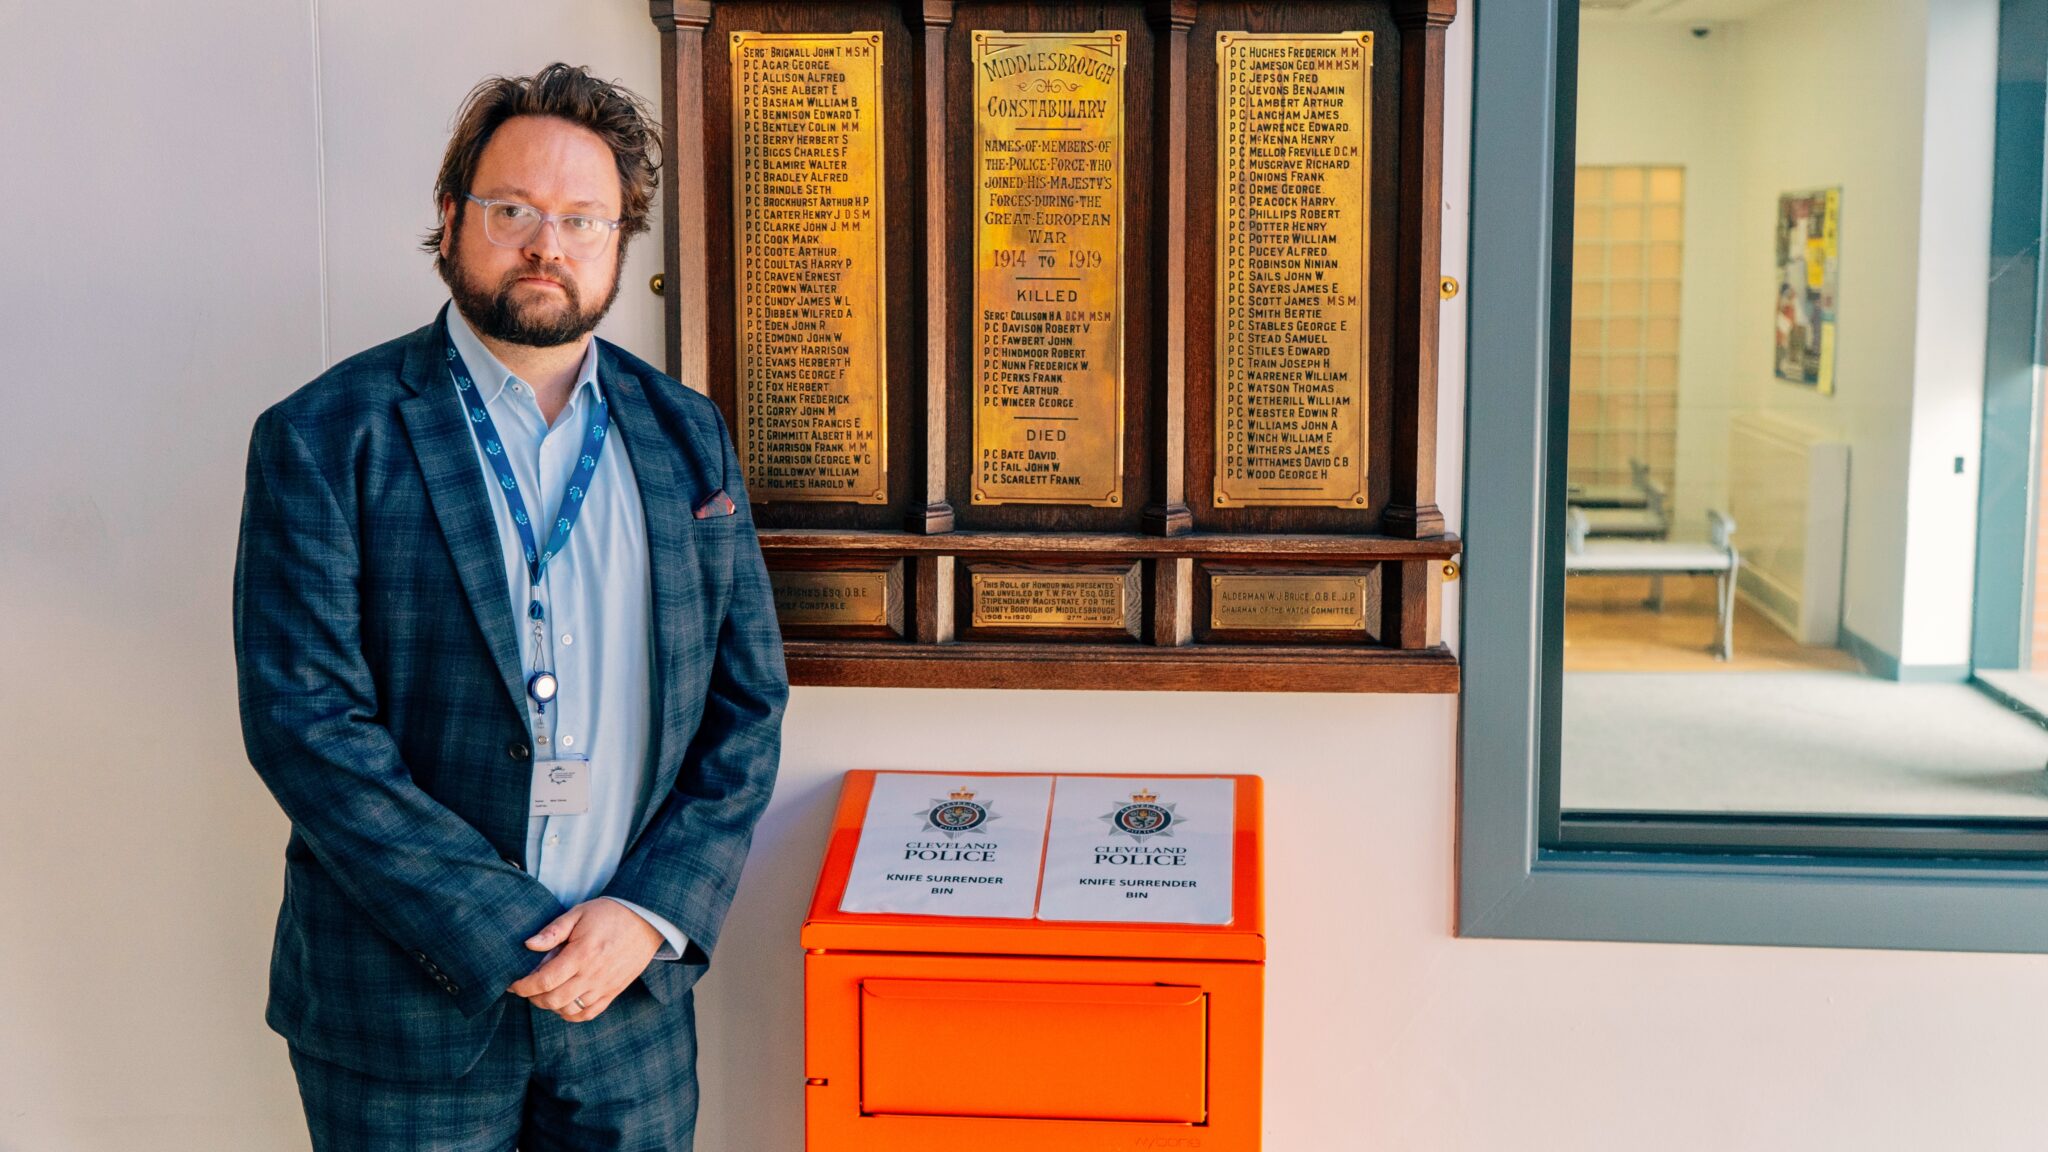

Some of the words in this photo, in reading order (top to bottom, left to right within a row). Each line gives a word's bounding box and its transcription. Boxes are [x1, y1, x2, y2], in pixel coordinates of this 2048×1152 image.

[983, 53, 1115, 84] MIDDLESBROUGH
[763, 73, 804, 82] ALLISON
[808, 73, 845, 82] ALFRED
[1249, 73, 1289, 82] JEPSON
[1293, 73, 1318, 82] FRED
[1249, 85, 1289, 95] JEVONS
[1293, 85, 1344, 95] BENJAMIN
[1250, 98, 1299, 107] LAMBERT
[1303, 98, 1343, 107] ARTHUR
[988, 96, 1107, 119] CONSTABULARY
[763, 160, 805, 169] BLAMIRE
[809, 160, 847, 169] WALTER
[1250, 160, 1302, 169] MUSGRAVE
[1306, 160, 1349, 169] RICHARD
[764, 172, 807, 182] BRADLEY
[811, 172, 848, 181] ALFRED
[1250, 173, 1287, 181] ONIONS
[1291, 173, 1324, 181] FRANK
[764, 185, 802, 194] BRINDLE
[806, 185, 831, 194] SETH
[1250, 197, 1298, 206] PEACOCK
[1301, 197, 1335, 206] HARRY
[1250, 209, 1296, 218] PHILLIPS
[1300, 209, 1340, 218] ROBERT
[1250, 222, 1289, 231] POTTER
[1292, 222, 1327, 231] HENRY
[764, 234, 789, 244] COOK
[793, 234, 819, 244] MARK
[1029, 229, 1066, 243] WAR
[1249, 234, 1289, 243] POTTER
[1292, 234, 1336, 243] WILLIAM
[764, 247, 794, 256] COOTE
[799, 247, 837, 256] ARTHUR
[994, 250, 1026, 268] 1914
[1039, 255, 1055, 267] TO
[1069, 250, 1101, 268] 1919
[1249, 259, 1300, 268] ROBINSON
[1304, 259, 1338, 268] NINIAN
[764, 272, 802, 281] CRAVEN
[806, 272, 841, 281] ERNEST
[764, 284, 796, 293] CROWN
[800, 284, 837, 293] WALTER
[1017, 290, 1078, 302] KILLED
[1011, 311, 1047, 321] COLLISON
[1249, 309, 1280, 318] SMITH
[1285, 309, 1322, 318] BERTIE
[1002, 323, 1042, 333] DAVISON
[1046, 323, 1081, 333] ROBERT
[1002, 336, 1044, 345] FAWBERT
[1048, 336, 1072, 345] JOHN
[1248, 334, 1281, 343] STEAD
[1285, 334, 1327, 343] SAMUEL
[1002, 348, 1048, 358] HINDMOOR
[1052, 349, 1085, 358] ROBERT
[1248, 346, 1284, 356] STILES
[1288, 346, 1330, 356] EDWARD
[1002, 360, 1026, 370] NUNN
[1029, 361, 1078, 370] FREDERICK
[1001, 373, 1030, 383] PERKS
[1033, 373, 1062, 383] FRANK
[766, 382, 783, 391] FOX
[787, 382, 829, 391] HERBERT
[1002, 385, 1019, 394] TYE
[1023, 385, 1059, 395] ARTHUR
[1248, 383, 1289, 393] WATSON
[1293, 383, 1334, 393] THOMAS
[766, 395, 796, 403] FRANK
[800, 395, 849, 403] FREDERICK
[1027, 430, 1066, 441] DIED
[1001, 449, 1024, 459] BATE
[1029, 450, 1056, 459] DAVID
[1247, 445, 1291, 454] WITHERS
[1295, 445, 1329, 454] JAMES
[768, 467, 815, 476] HOLLOWAY
[819, 467, 859, 476] WILLIAM
[1001, 462, 1021, 471] FAIL
[1025, 462, 1049, 472] JOHN
[1001, 474, 1046, 484] SCARLETT
[1051, 474, 1080, 484] FRANK
[906, 842, 998, 850] CLEVELAND
[1095, 846, 1187, 854] CLEVELAND
[904, 849, 996, 862] POLICE
[1094, 854, 1187, 866] POLICE
[886, 874, 923, 883] KNIFE
[927, 875, 1003, 885] SURRENDER
[1079, 878, 1115, 887] KNIFE
[1119, 879, 1197, 888] SURRENDER
[931, 887, 953, 895] BIN
